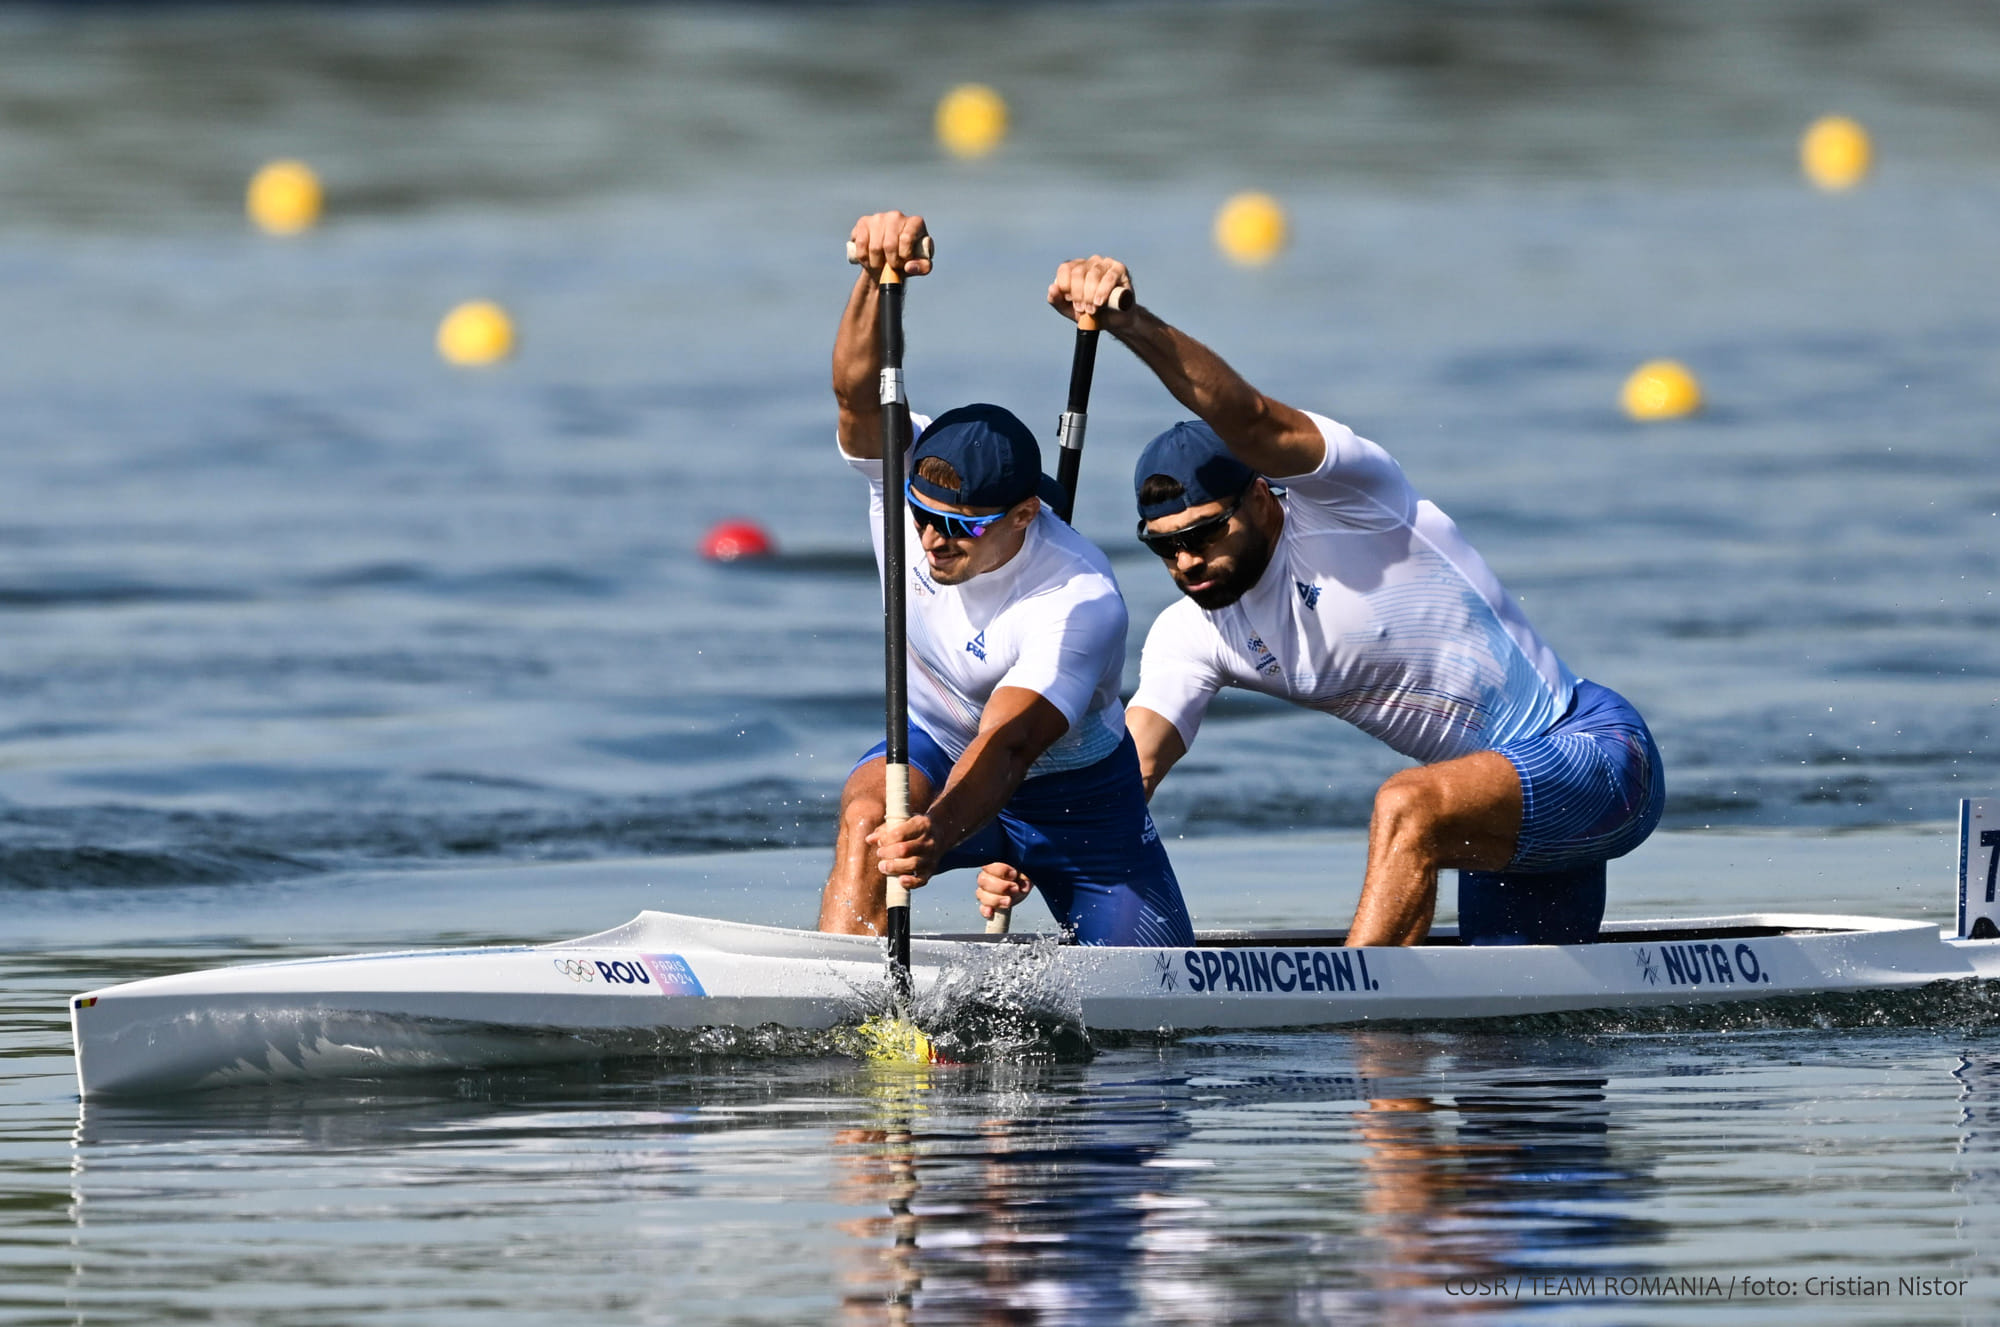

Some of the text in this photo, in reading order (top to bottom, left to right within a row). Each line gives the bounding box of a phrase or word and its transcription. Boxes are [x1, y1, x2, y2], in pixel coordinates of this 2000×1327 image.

[965, 641, 987, 664] PEAK
[1980, 830, 2000, 902] 7
[595, 961, 650, 984] ROU
[652, 959, 686, 972] PARIS
[1184, 949, 1379, 993] SPRINCEAN I.
[1660, 943, 1769, 985] NUTA O.
[660, 972, 695, 985] 2024
